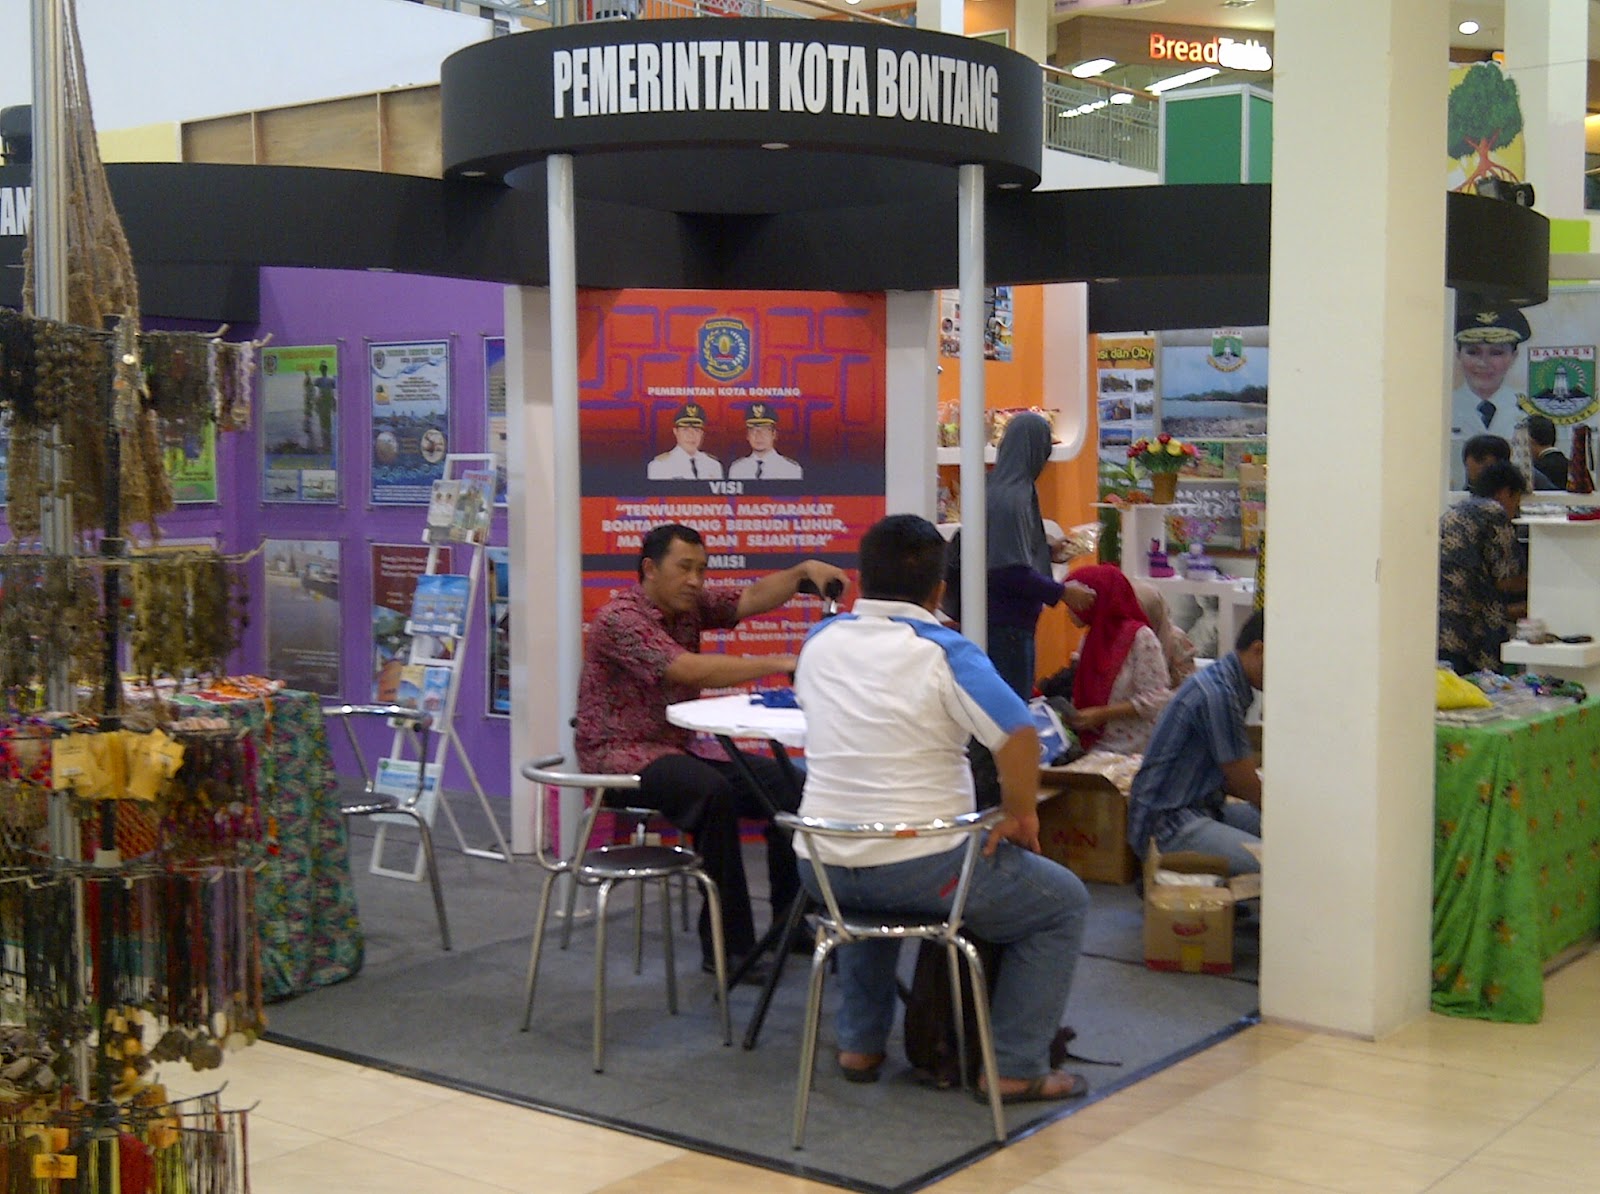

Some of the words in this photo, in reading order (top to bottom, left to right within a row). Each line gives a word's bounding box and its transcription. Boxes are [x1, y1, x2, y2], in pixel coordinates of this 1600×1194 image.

[553, 41, 769, 119] PEMERINTAH
[778, 42, 870, 114] KOTA
[877, 48, 999, 134] BONTANG
[1131, 346, 1154, 362] Oby
[1532, 348, 1590, 357] BANTEN
[647, 387, 715, 396] PEMERINTAH
[718, 387, 747, 396] KOTA
[749, 387, 801, 397] BONTANG
[709, 481, 743, 496] VISI
[737, 503, 835, 516] MASYARAKAT
[725, 519, 790, 531] BERBUDI
[705, 534, 738, 547] DAN
[707, 554, 746, 569] MISI
